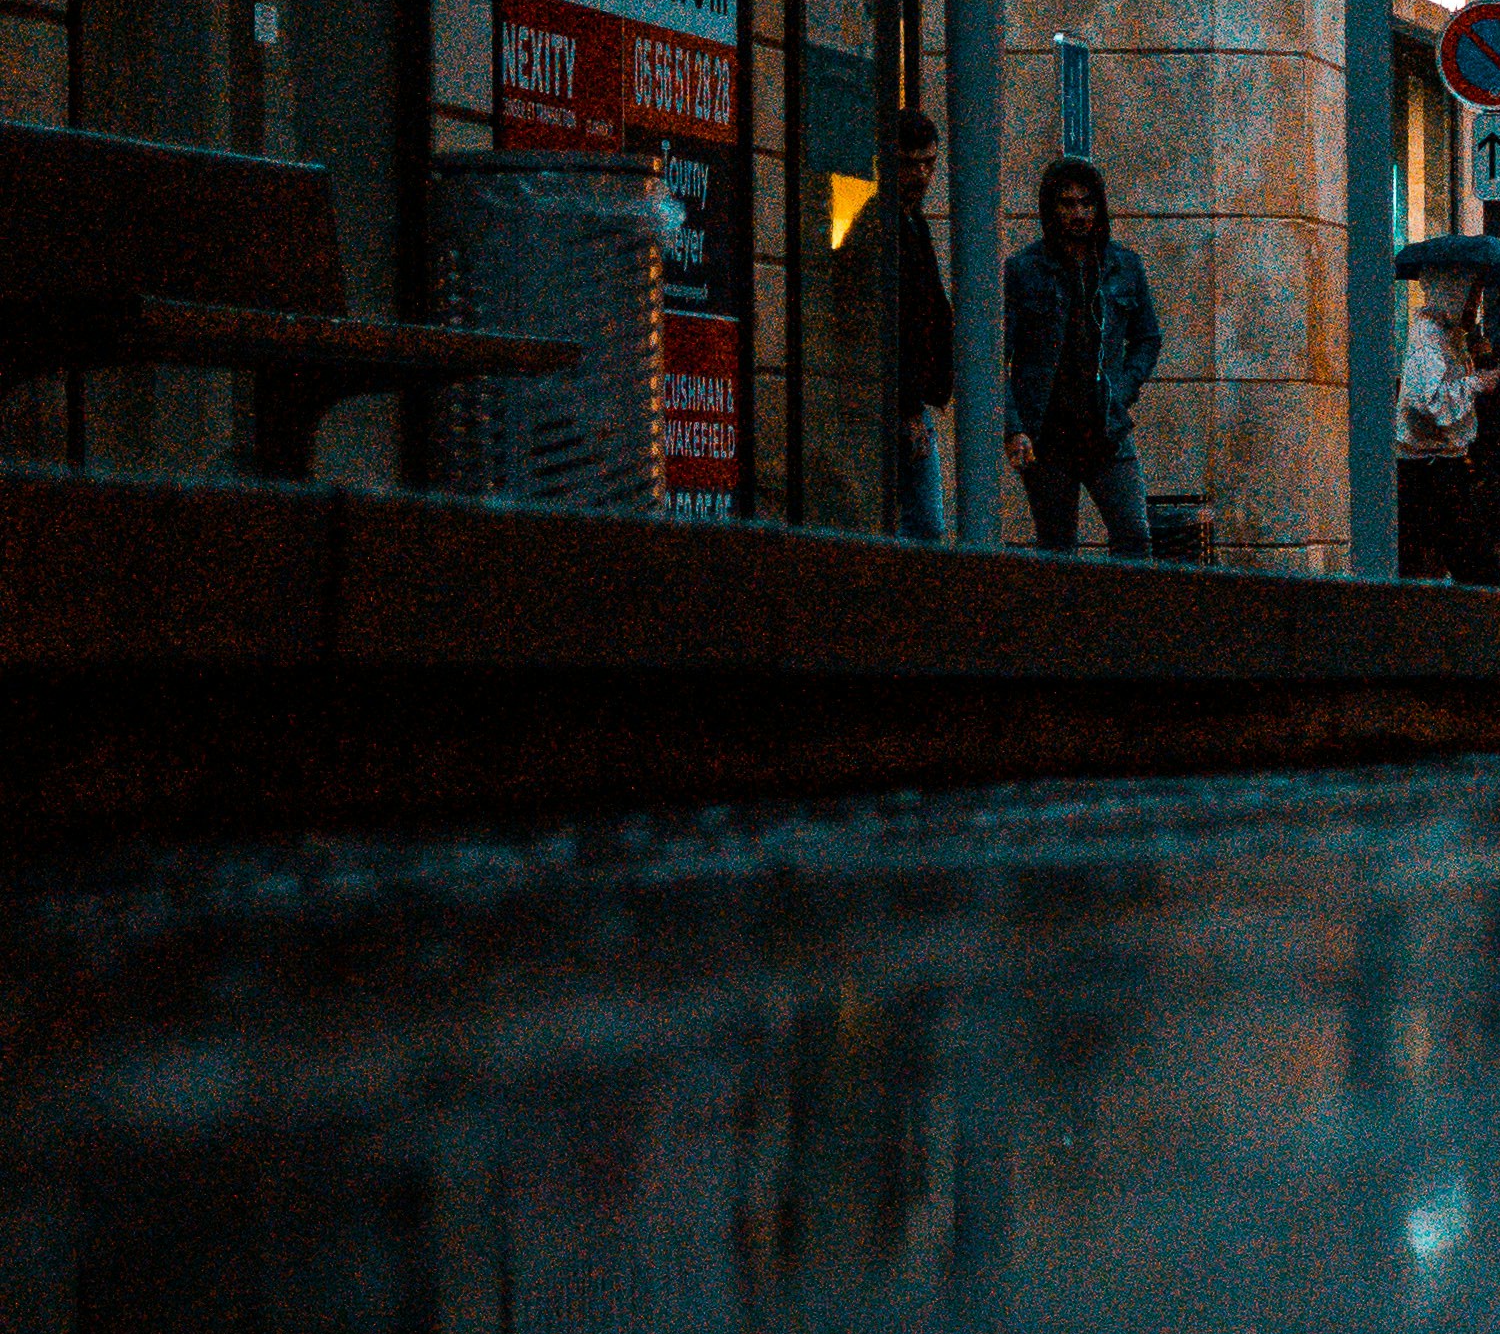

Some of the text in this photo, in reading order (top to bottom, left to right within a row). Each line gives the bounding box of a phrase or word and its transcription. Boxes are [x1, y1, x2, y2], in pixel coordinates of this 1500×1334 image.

[502, 21, 577, 99] NEXITY
[634, 35, 652, 107] 05
[662, 227, 706, 273] eyer
[663, 373, 724, 413] CUSHMAN
[664, 419, 737, 460] WAKEFIELD
